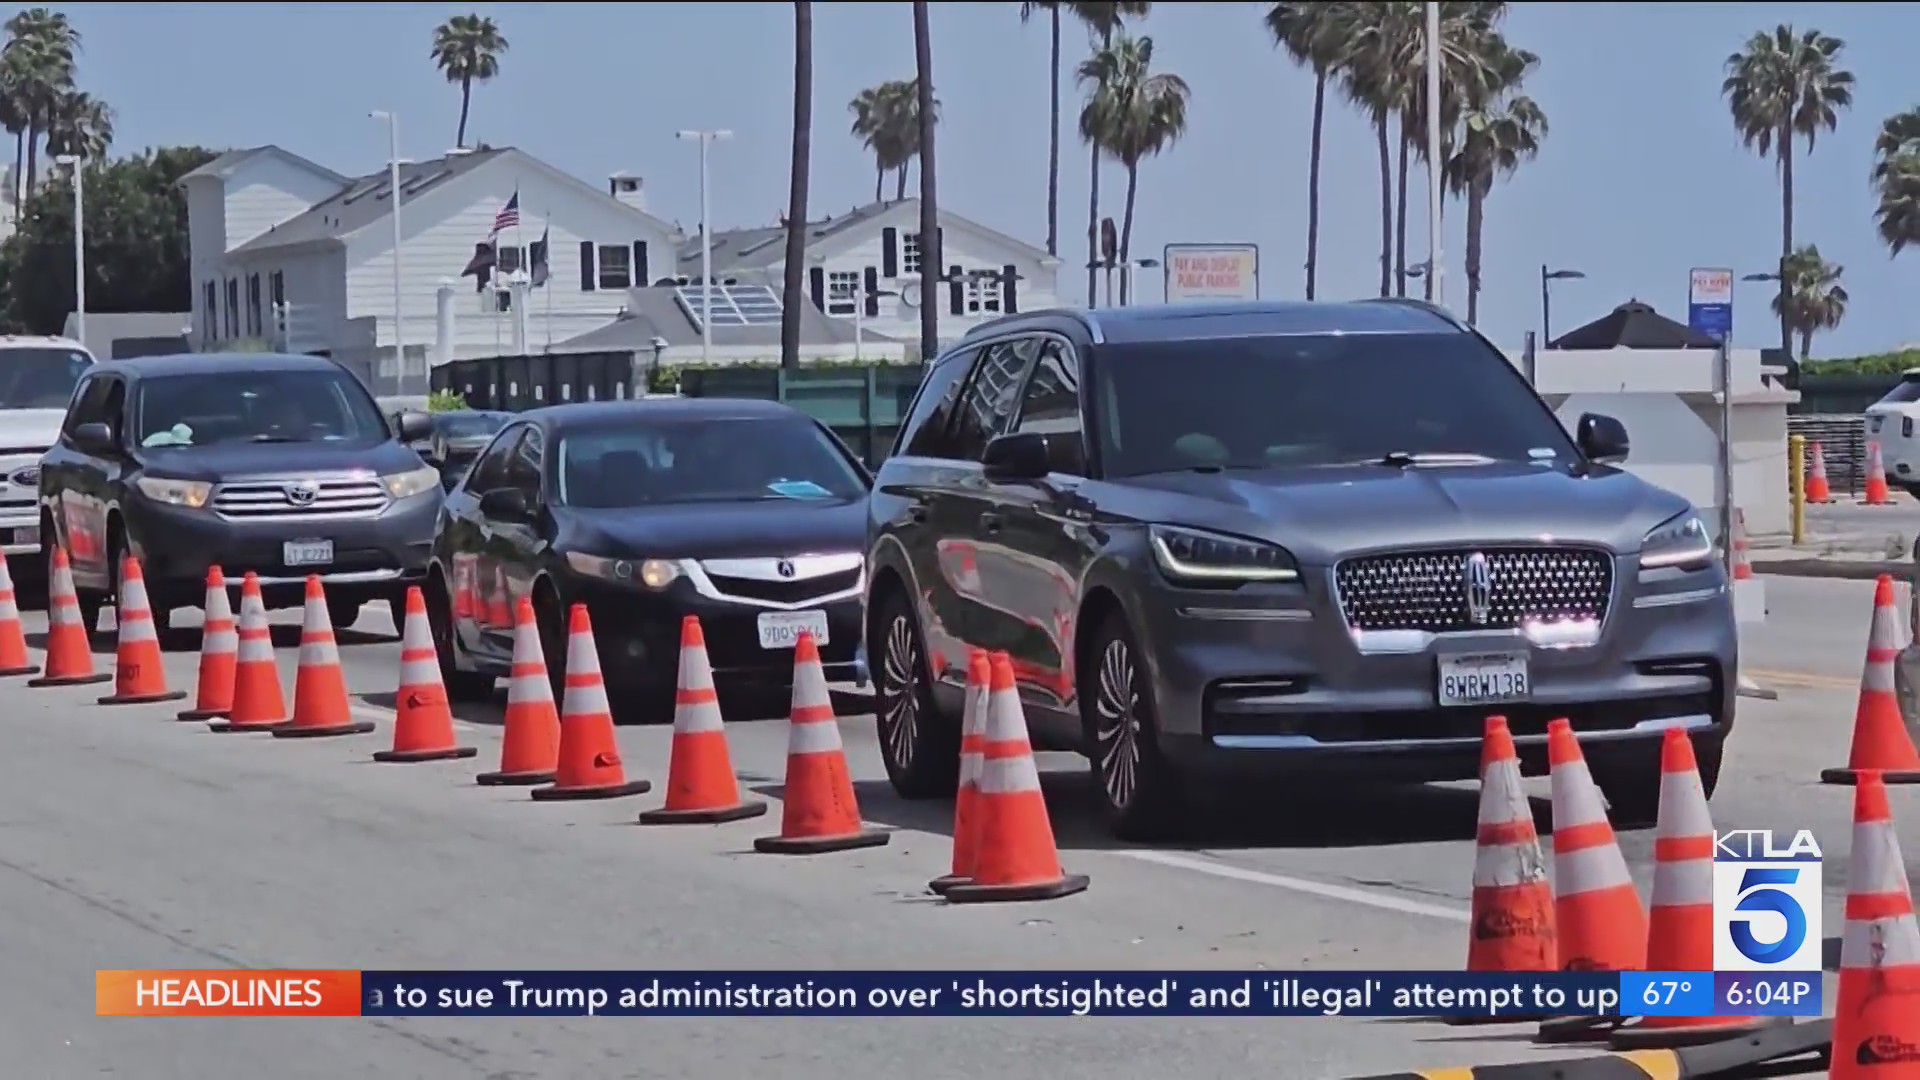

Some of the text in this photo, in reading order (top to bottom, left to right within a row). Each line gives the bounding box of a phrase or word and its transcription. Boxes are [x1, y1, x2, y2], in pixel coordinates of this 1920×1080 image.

[1177, 273, 1240, 288] PUBLIC PARKING
[1445, 672, 1525, 698] 8WRW138
